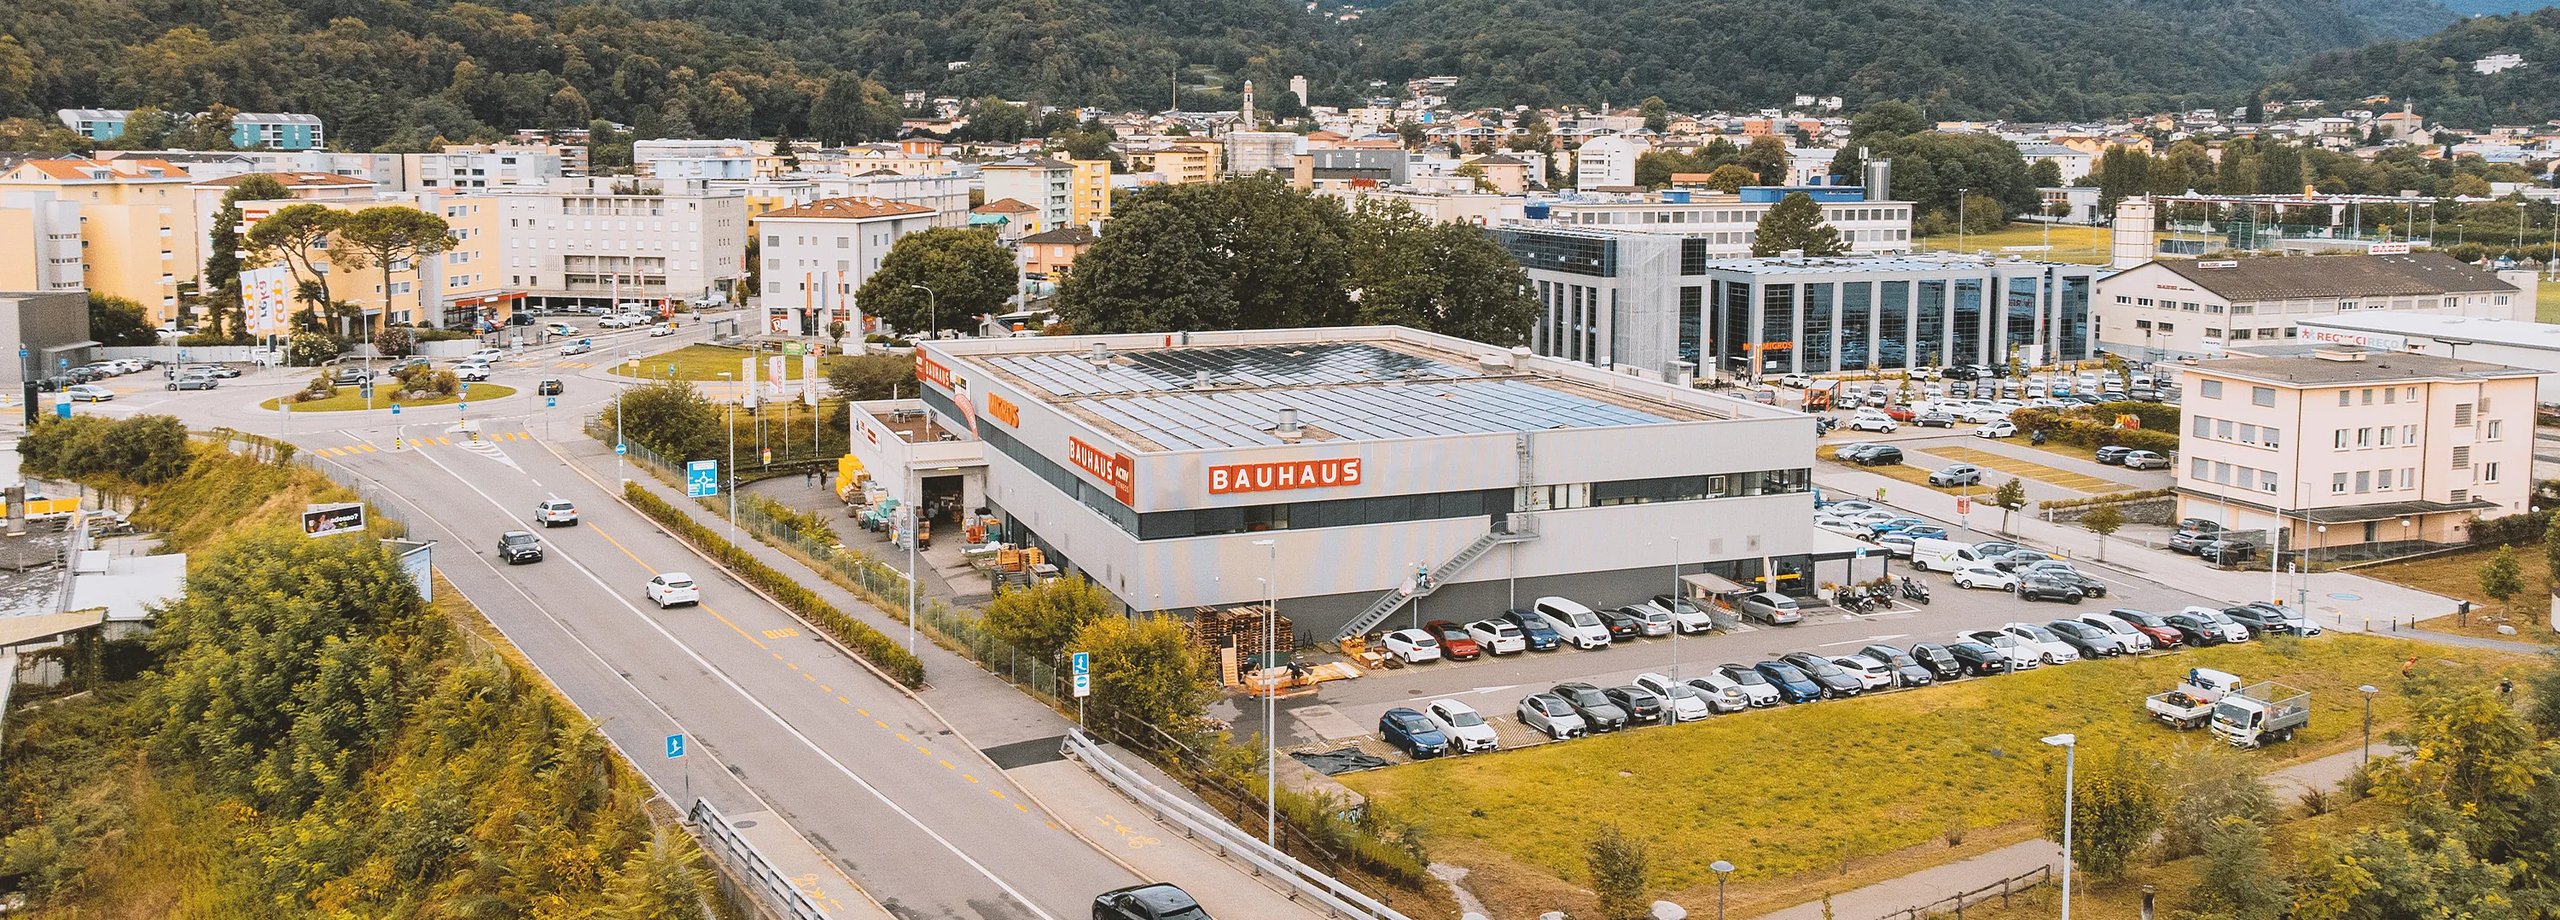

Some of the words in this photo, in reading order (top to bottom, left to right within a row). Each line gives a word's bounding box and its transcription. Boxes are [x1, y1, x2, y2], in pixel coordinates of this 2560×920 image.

[1762, 341, 1793, 350] MIGROS
[2317, 332, 2367, 346] REGCI
[988, 392, 1020, 429] MIGROS
[1069, 440, 1113, 481] BAUHAUS
[1115, 465, 1129, 483] ACTIV
[1213, 462, 1359, 490] BAUHAUS
